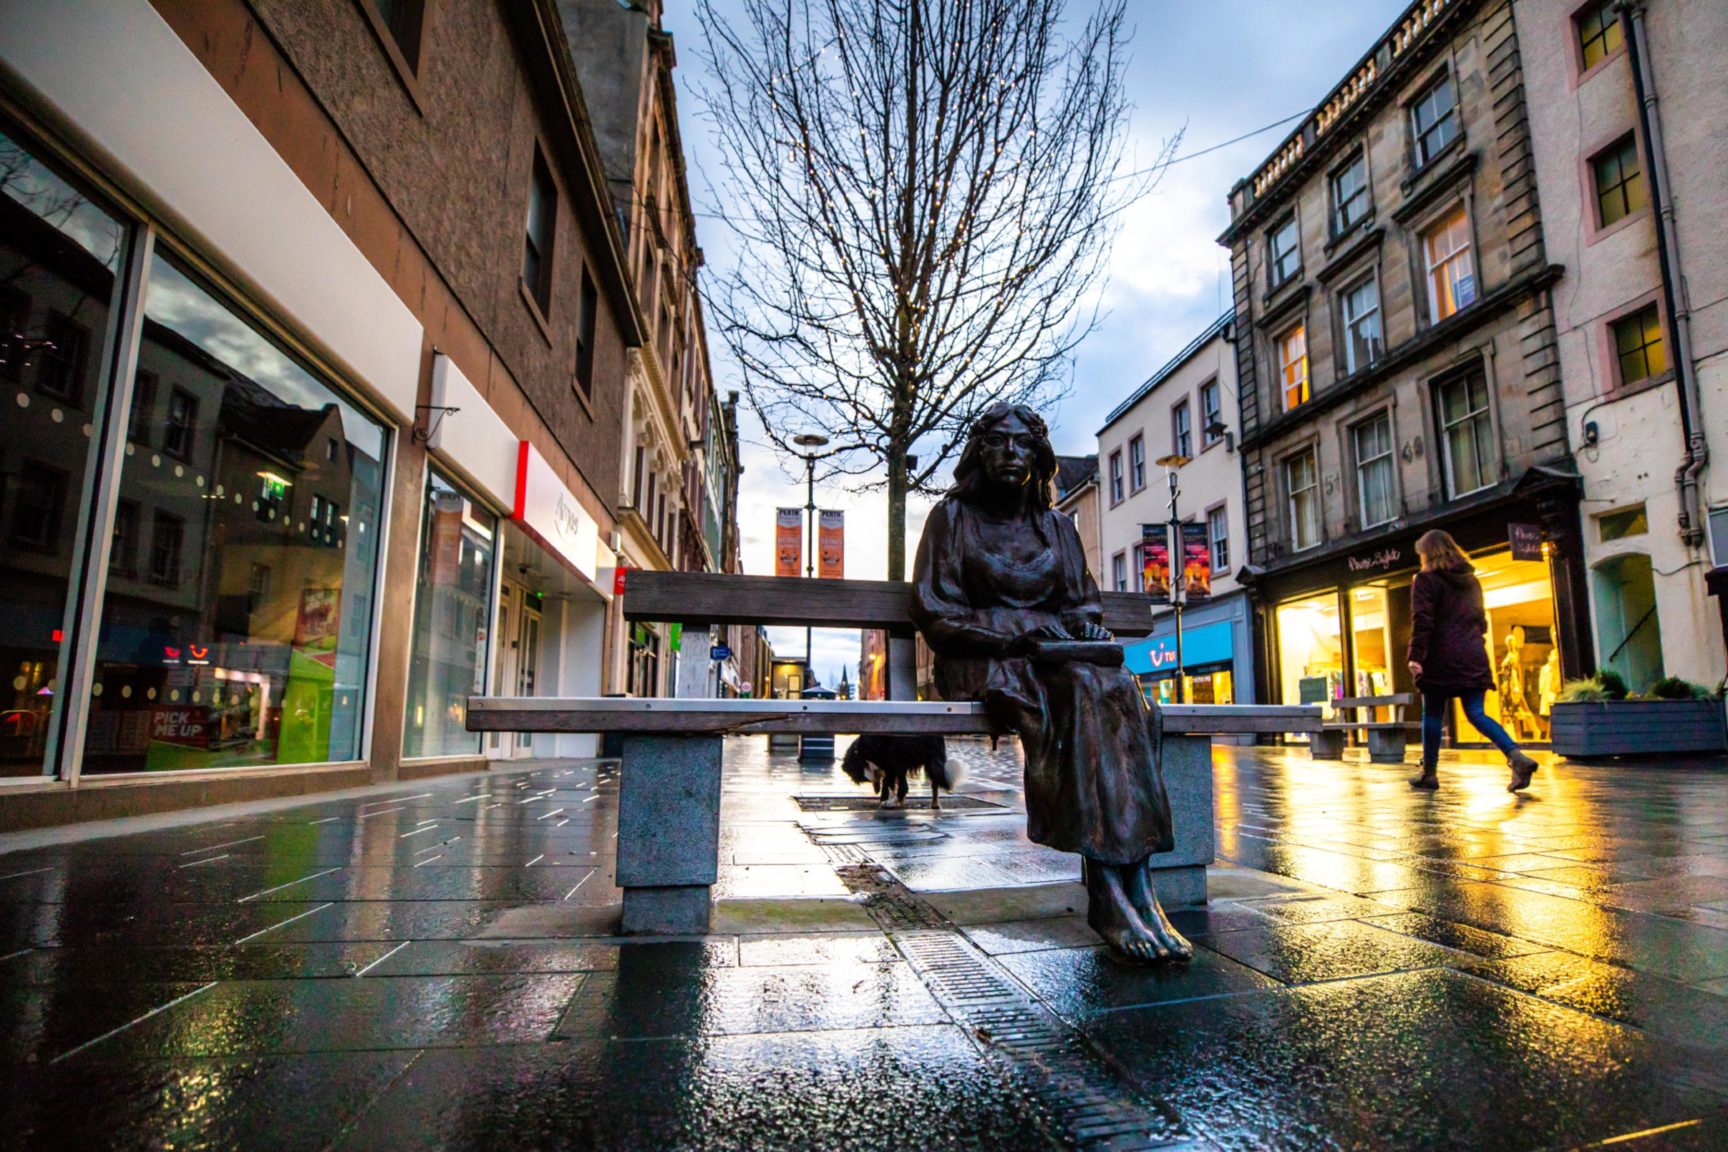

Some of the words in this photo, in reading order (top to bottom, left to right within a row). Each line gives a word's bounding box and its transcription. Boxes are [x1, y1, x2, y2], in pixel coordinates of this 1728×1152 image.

[153, 711, 191, 725] PICK
[154, 724, 178, 737] ME
[180, 724, 203, 737] UP
